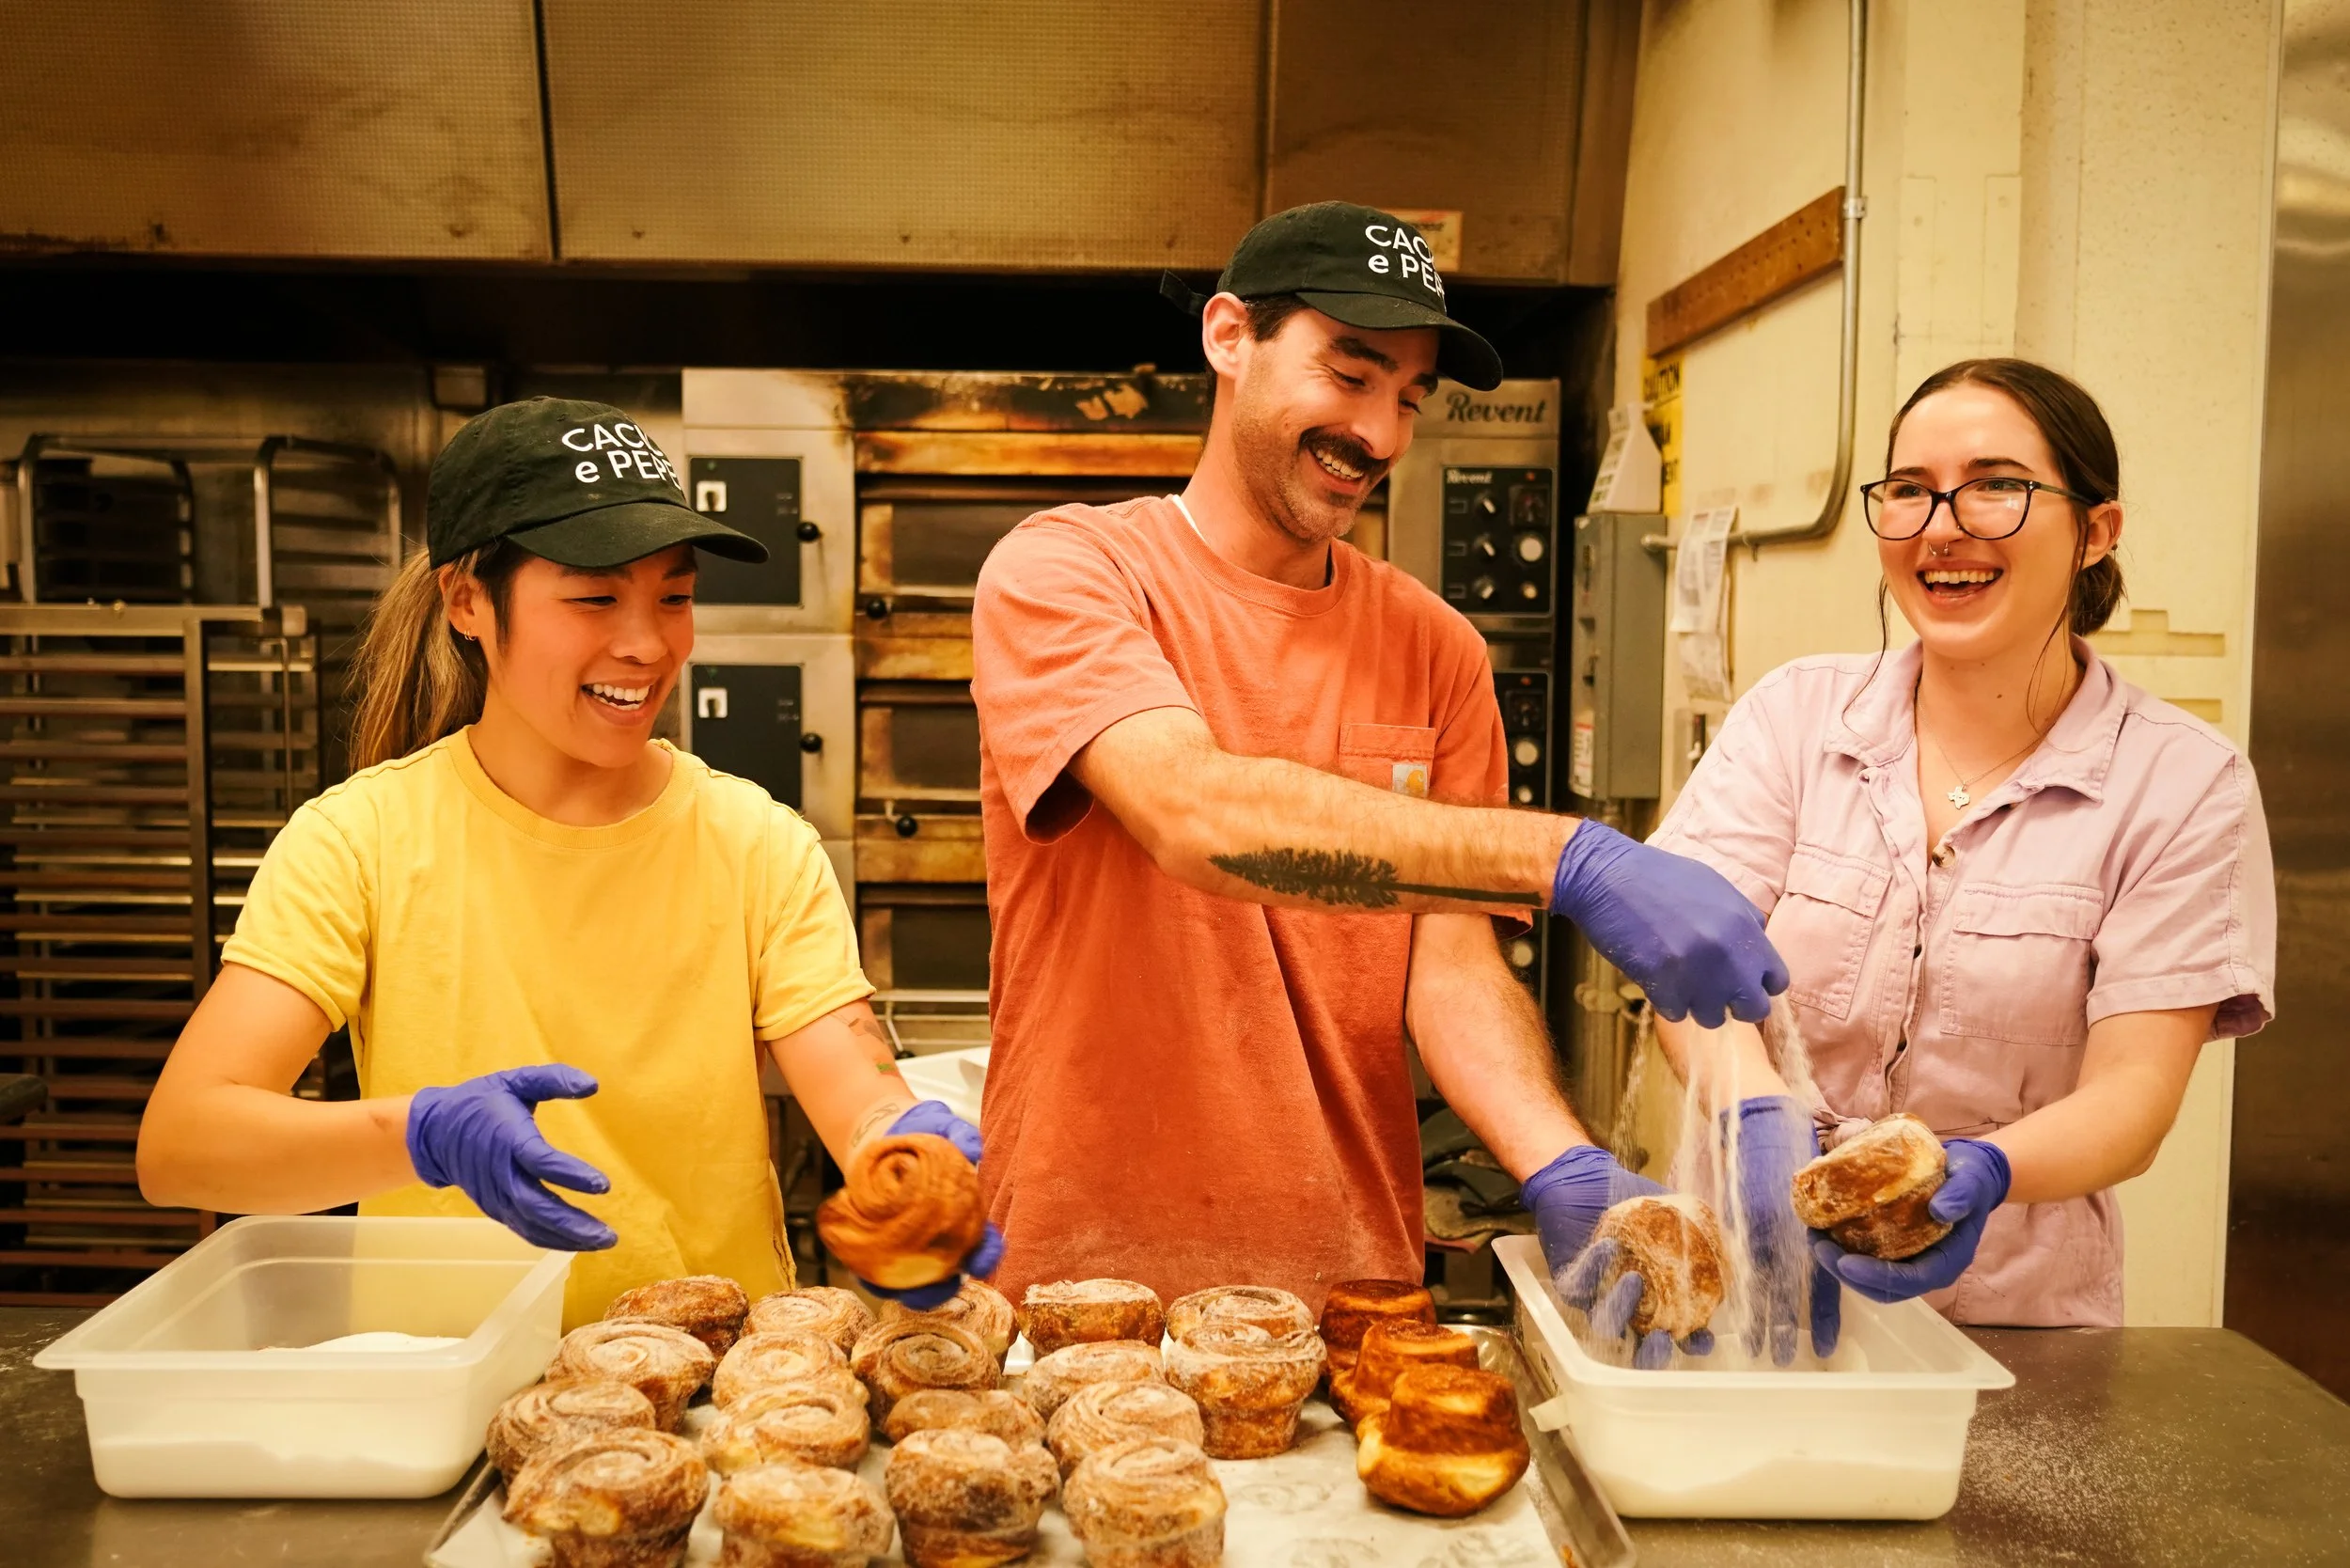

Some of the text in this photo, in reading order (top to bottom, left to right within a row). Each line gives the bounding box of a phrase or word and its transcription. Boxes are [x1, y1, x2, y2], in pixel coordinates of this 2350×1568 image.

[1368, 253, 1447, 313] e PEP
[1446, 390, 1546, 423] Revent
[575, 449, 682, 491] e PEPE
[1447, 469, 1493, 484] Revent
